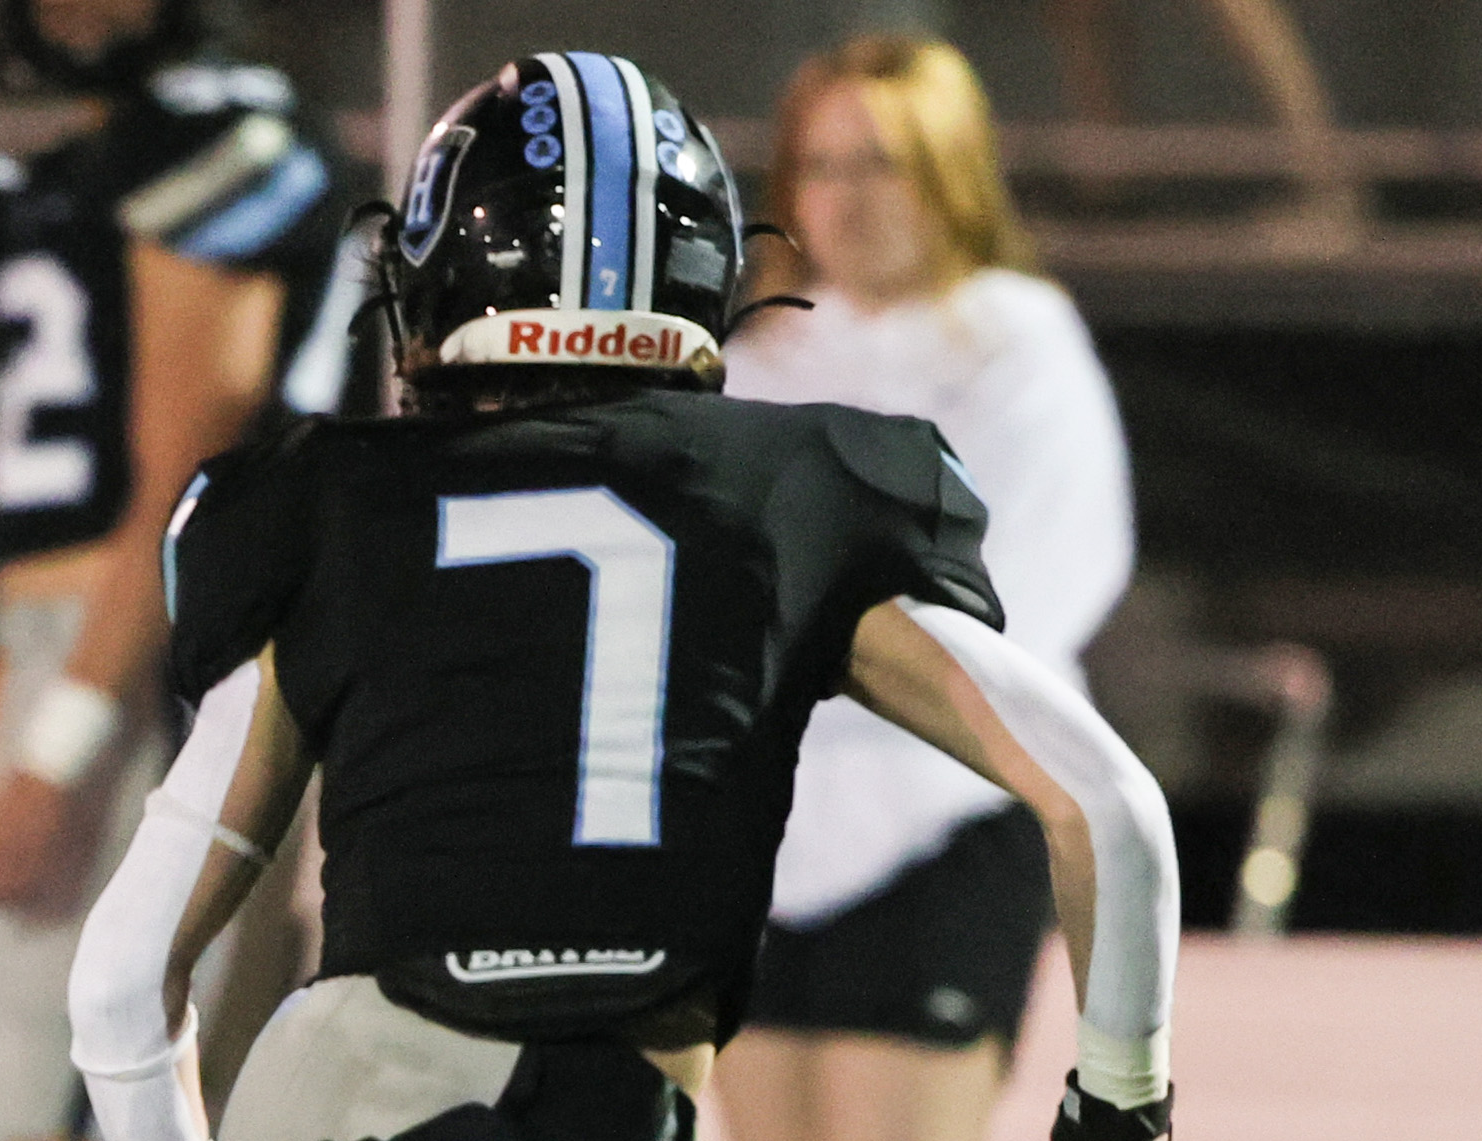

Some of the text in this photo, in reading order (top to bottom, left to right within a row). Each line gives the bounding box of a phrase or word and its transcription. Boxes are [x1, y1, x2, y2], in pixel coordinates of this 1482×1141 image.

[598, 268, 618, 296] 7
[507, 320, 683, 362] Riddell
[435, 485, 676, 847] 7
